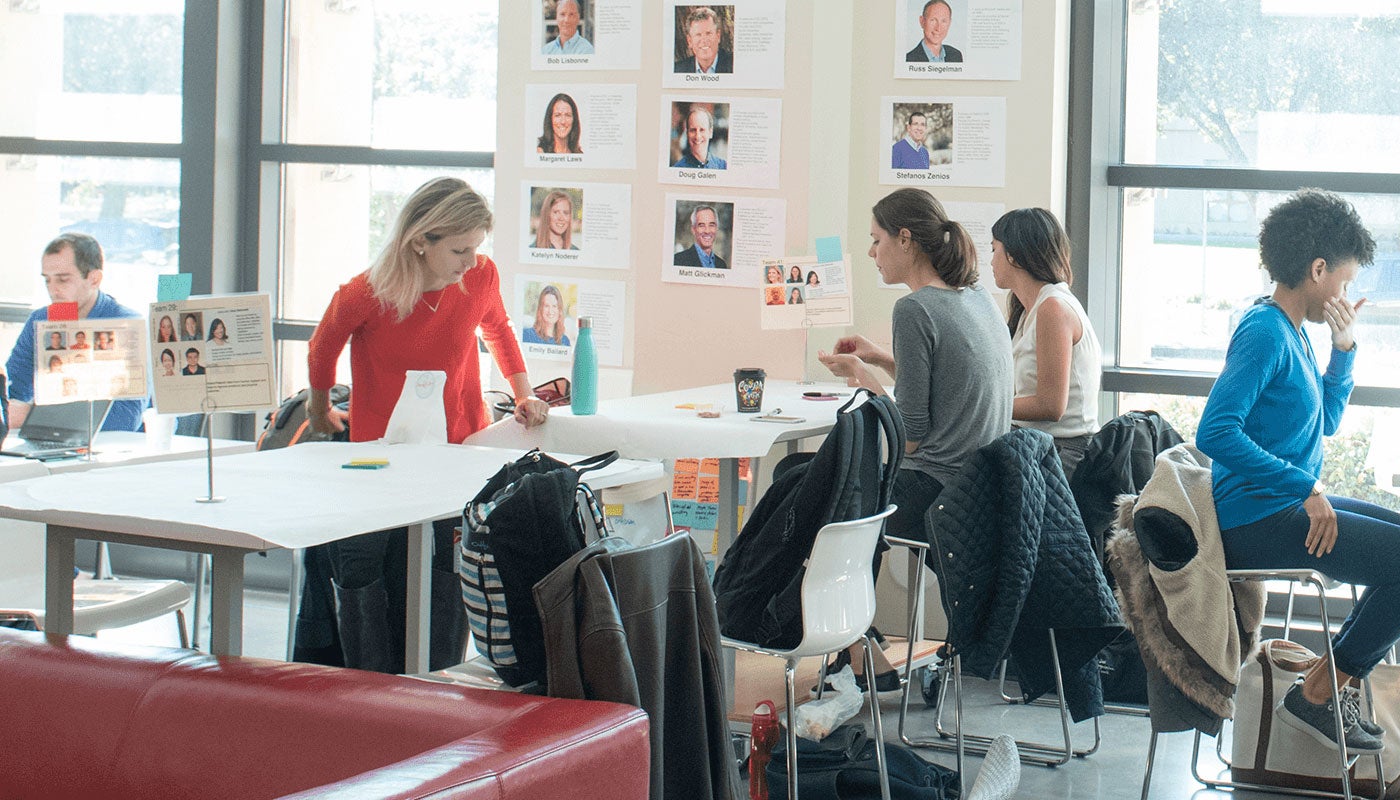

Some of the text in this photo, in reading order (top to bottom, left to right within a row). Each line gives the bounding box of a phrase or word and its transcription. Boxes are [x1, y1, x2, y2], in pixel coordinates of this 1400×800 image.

[908, 65, 963, 74] Russ Siegelman
[700, 74, 720, 82] Wood
[539, 155, 566, 163] Margaret
[678, 171, 717, 180] Doug Galen
[896, 172, 950, 180] Stefanos Zenios
[531, 251, 579, 261] Katelyn Noderer
[679, 269, 726, 279] Matt Glickman
[529, 346, 568, 356] Emily Ballard
